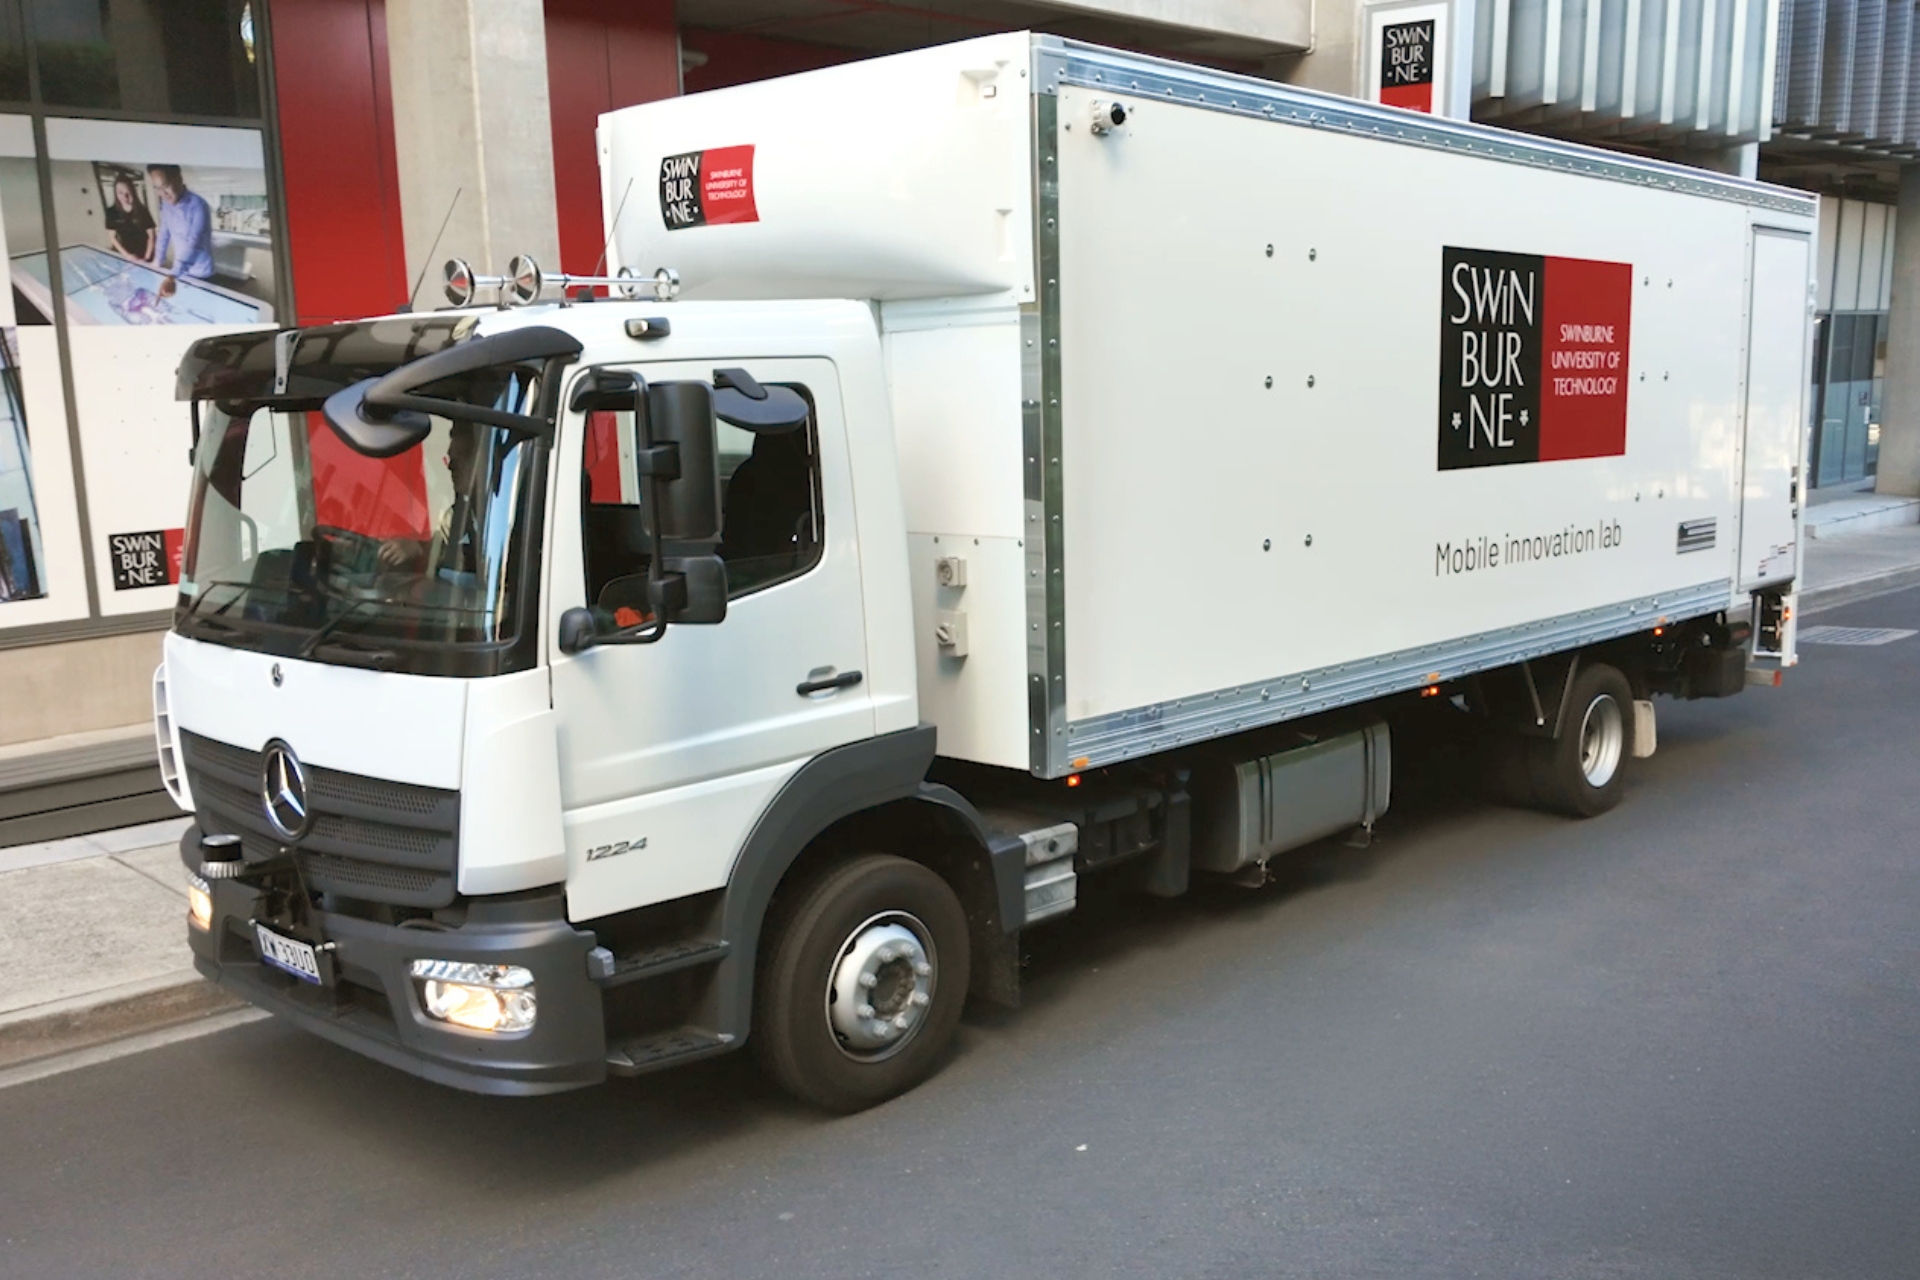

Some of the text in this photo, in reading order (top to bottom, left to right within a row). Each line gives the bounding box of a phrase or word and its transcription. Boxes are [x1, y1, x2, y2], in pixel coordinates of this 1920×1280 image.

[1391, 45, 1425, 65] BUR
[710, 168, 742, 180] SWINBURNE
[665, 178, 694, 202] BUR
[706, 180, 738, 191] UNIVERSITY
[708, 190, 747, 201] TECHNOLOGY
[1560, 324, 1614, 343] SWINBURNE
[1461, 331, 1524, 387] BUR
[1551, 351, 1621, 370] UNIVERSITY OF
[1553, 377, 1618, 396] TECHNOLOGY
[1436, 518, 1622, 576] Mobile innovation lab
[121, 551, 159, 570] BUR
[586, 836, 647, 862] 1224
